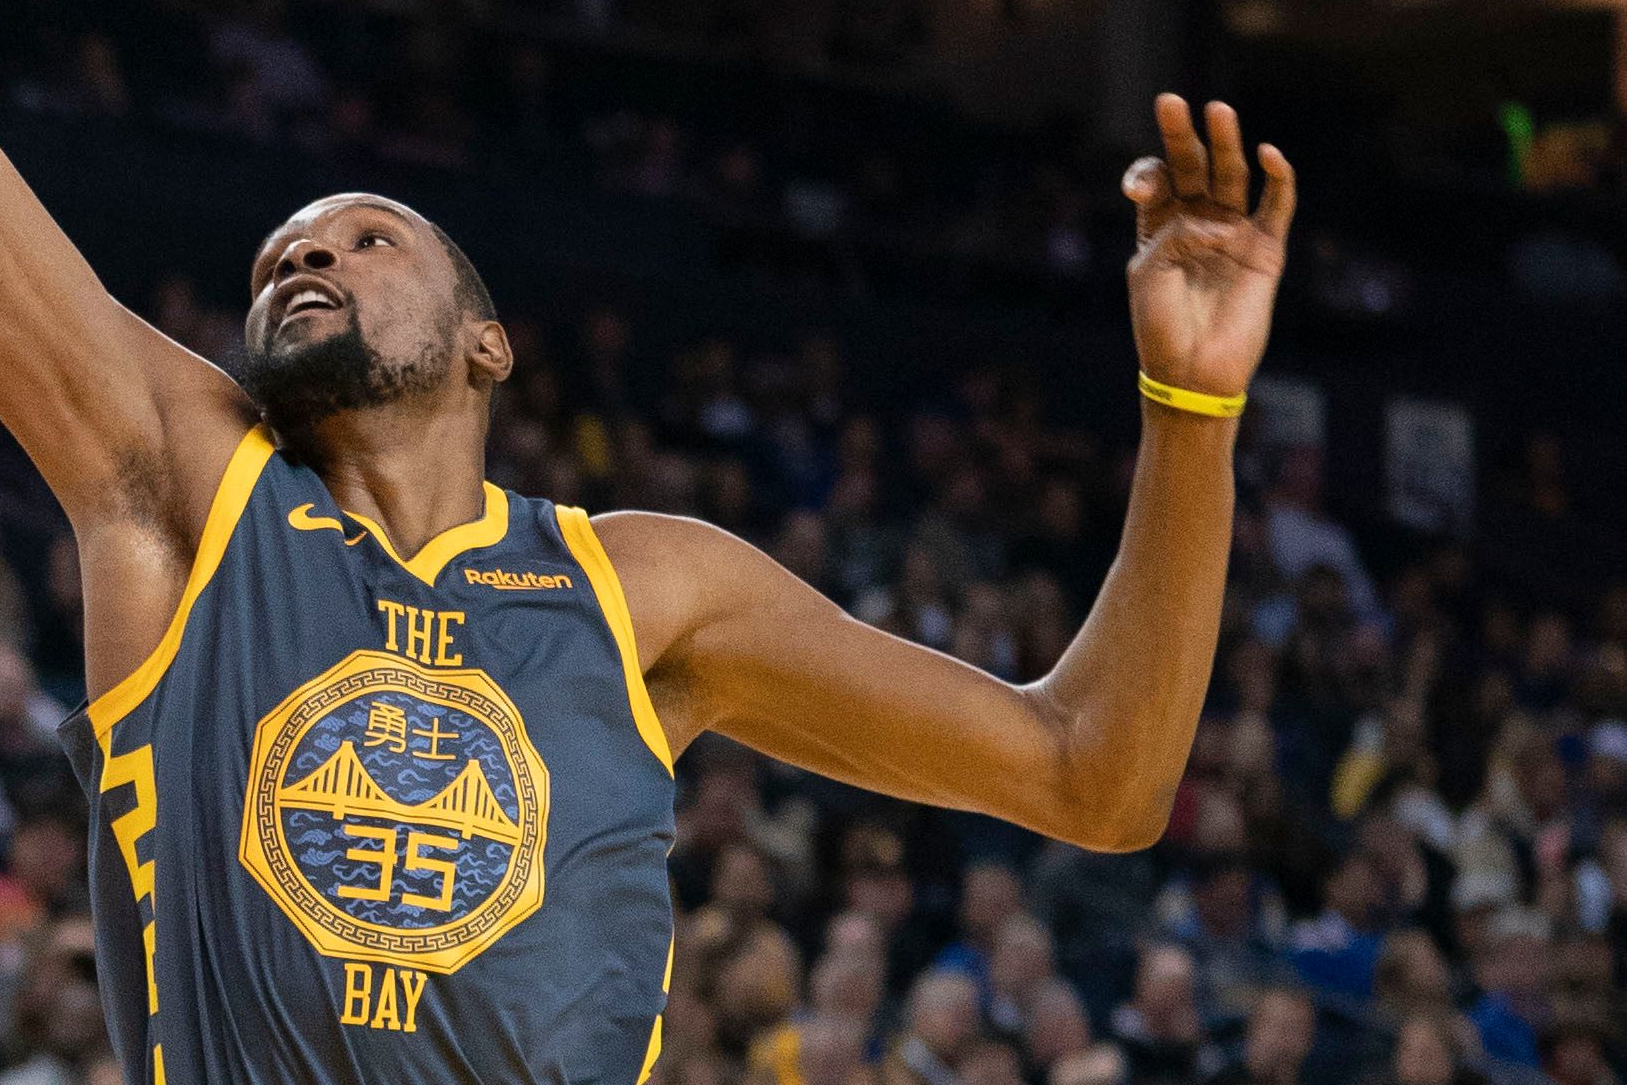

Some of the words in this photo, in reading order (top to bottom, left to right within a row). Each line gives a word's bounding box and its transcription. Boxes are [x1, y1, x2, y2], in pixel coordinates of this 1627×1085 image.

[463, 568, 573, 590] Rakuten
[378, 600, 465, 666] THE
[363, 701, 460, 760] 勇士
[337, 824, 459, 912] 35
[340, 962, 428, 1033] BAY
